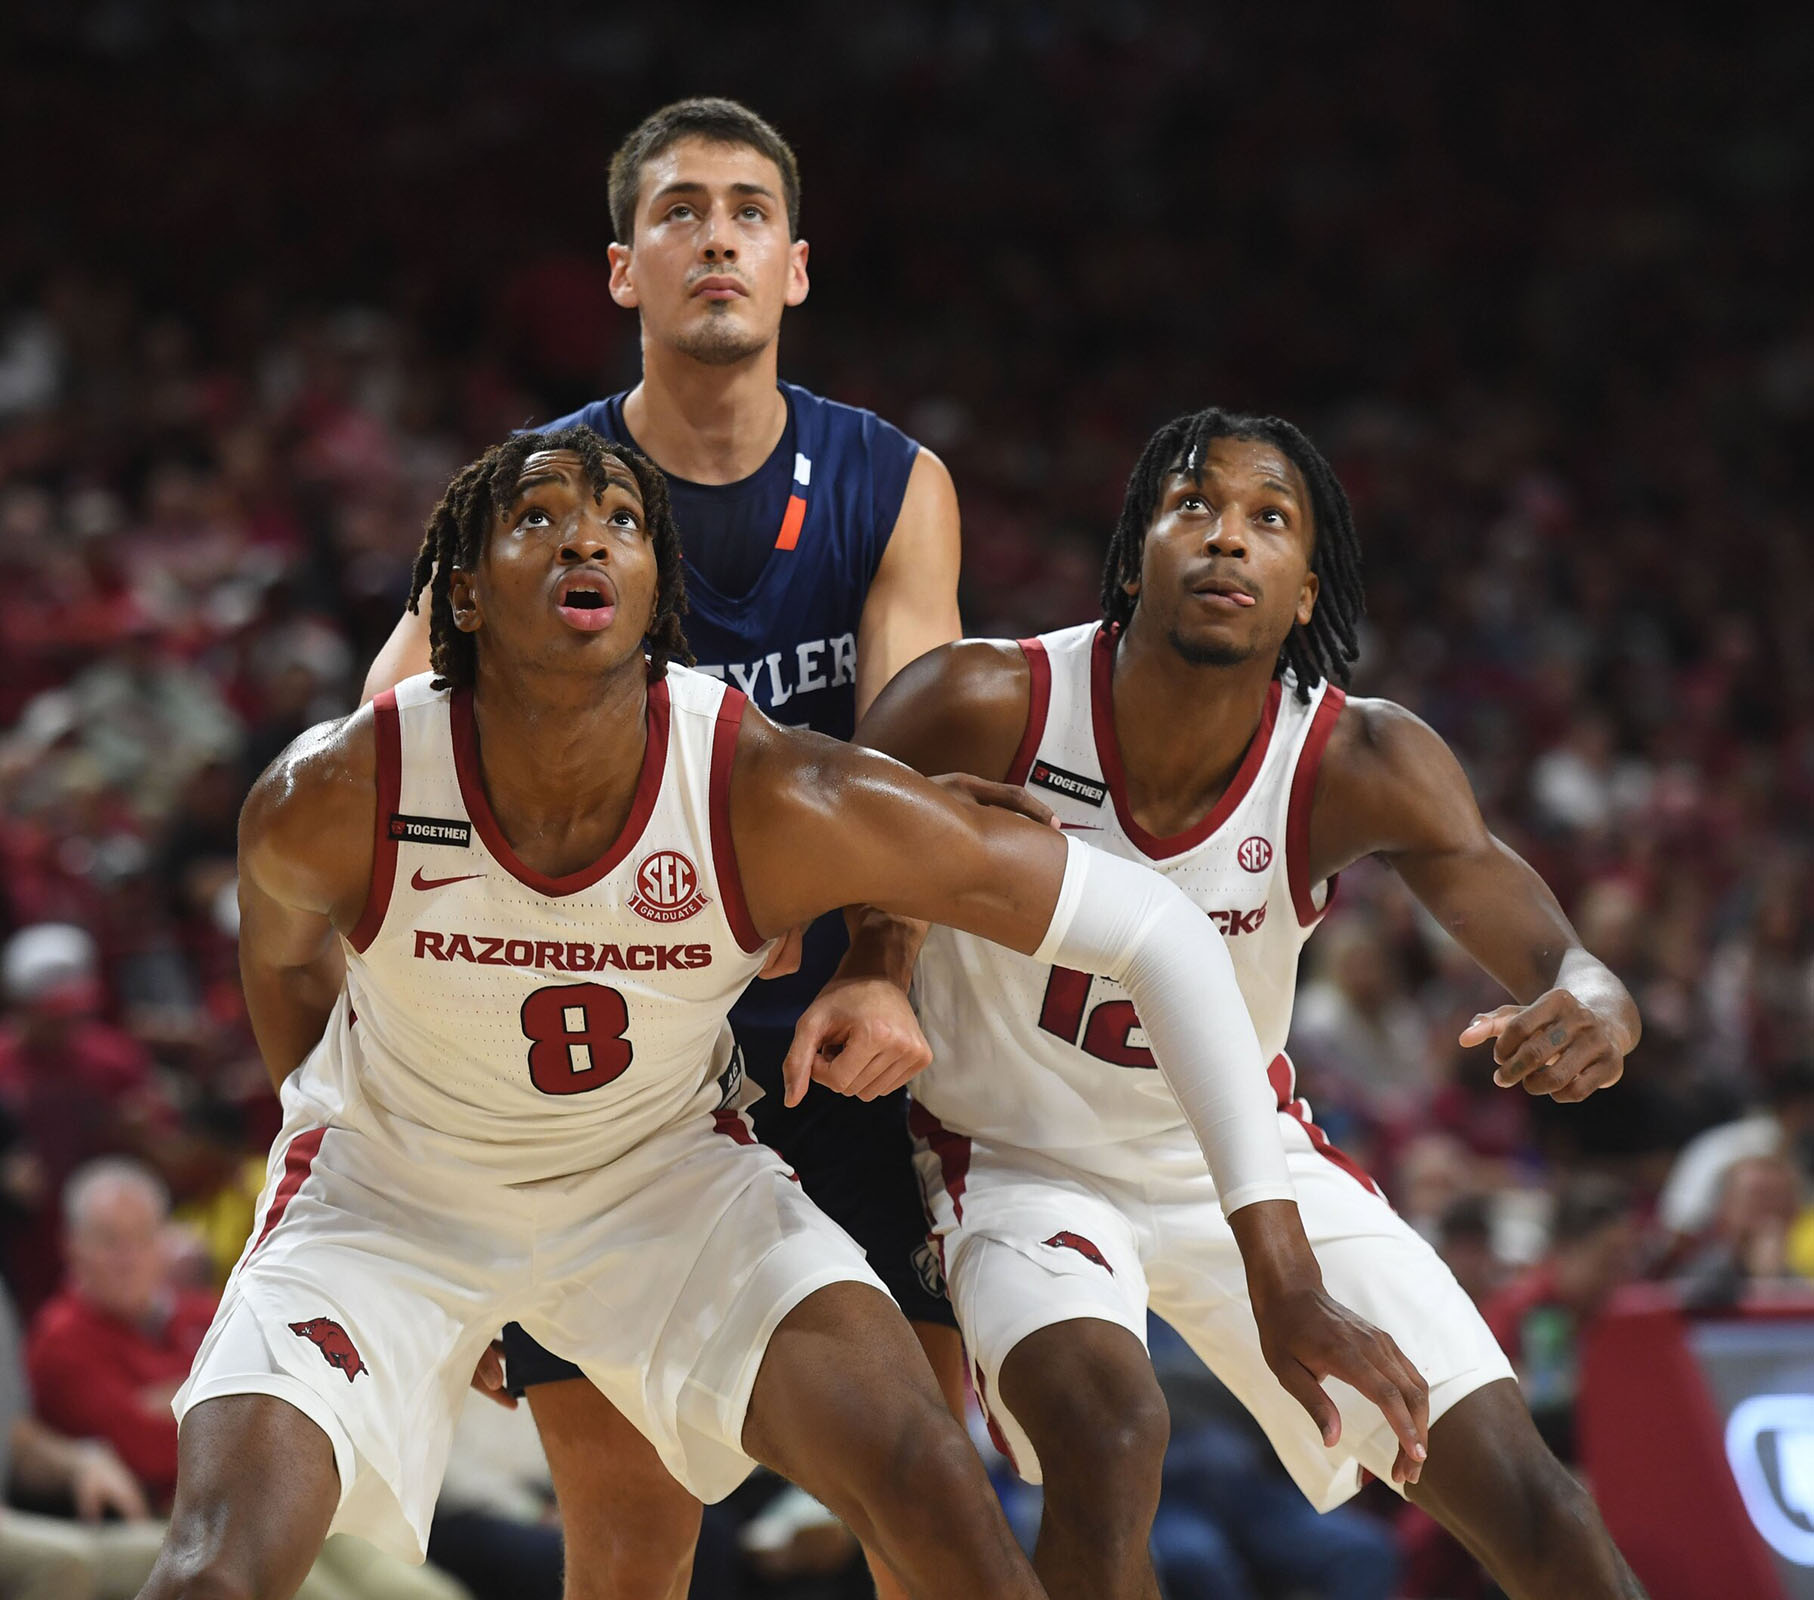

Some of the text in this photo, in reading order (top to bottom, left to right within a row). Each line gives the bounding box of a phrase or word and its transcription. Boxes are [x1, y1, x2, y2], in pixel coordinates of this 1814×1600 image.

[691, 633, 857, 708] YLER
[1048, 772, 1104, 801] TOGETHER
[406, 823, 468, 841] TOGETHER
[1240, 839, 1270, 870] SEC
[643, 855, 691, 904] SEC
[640, 903, 697, 921] GRADUATE
[413, 929, 713, 972] RAZORBACKS
[520, 981, 634, 1095] 8
